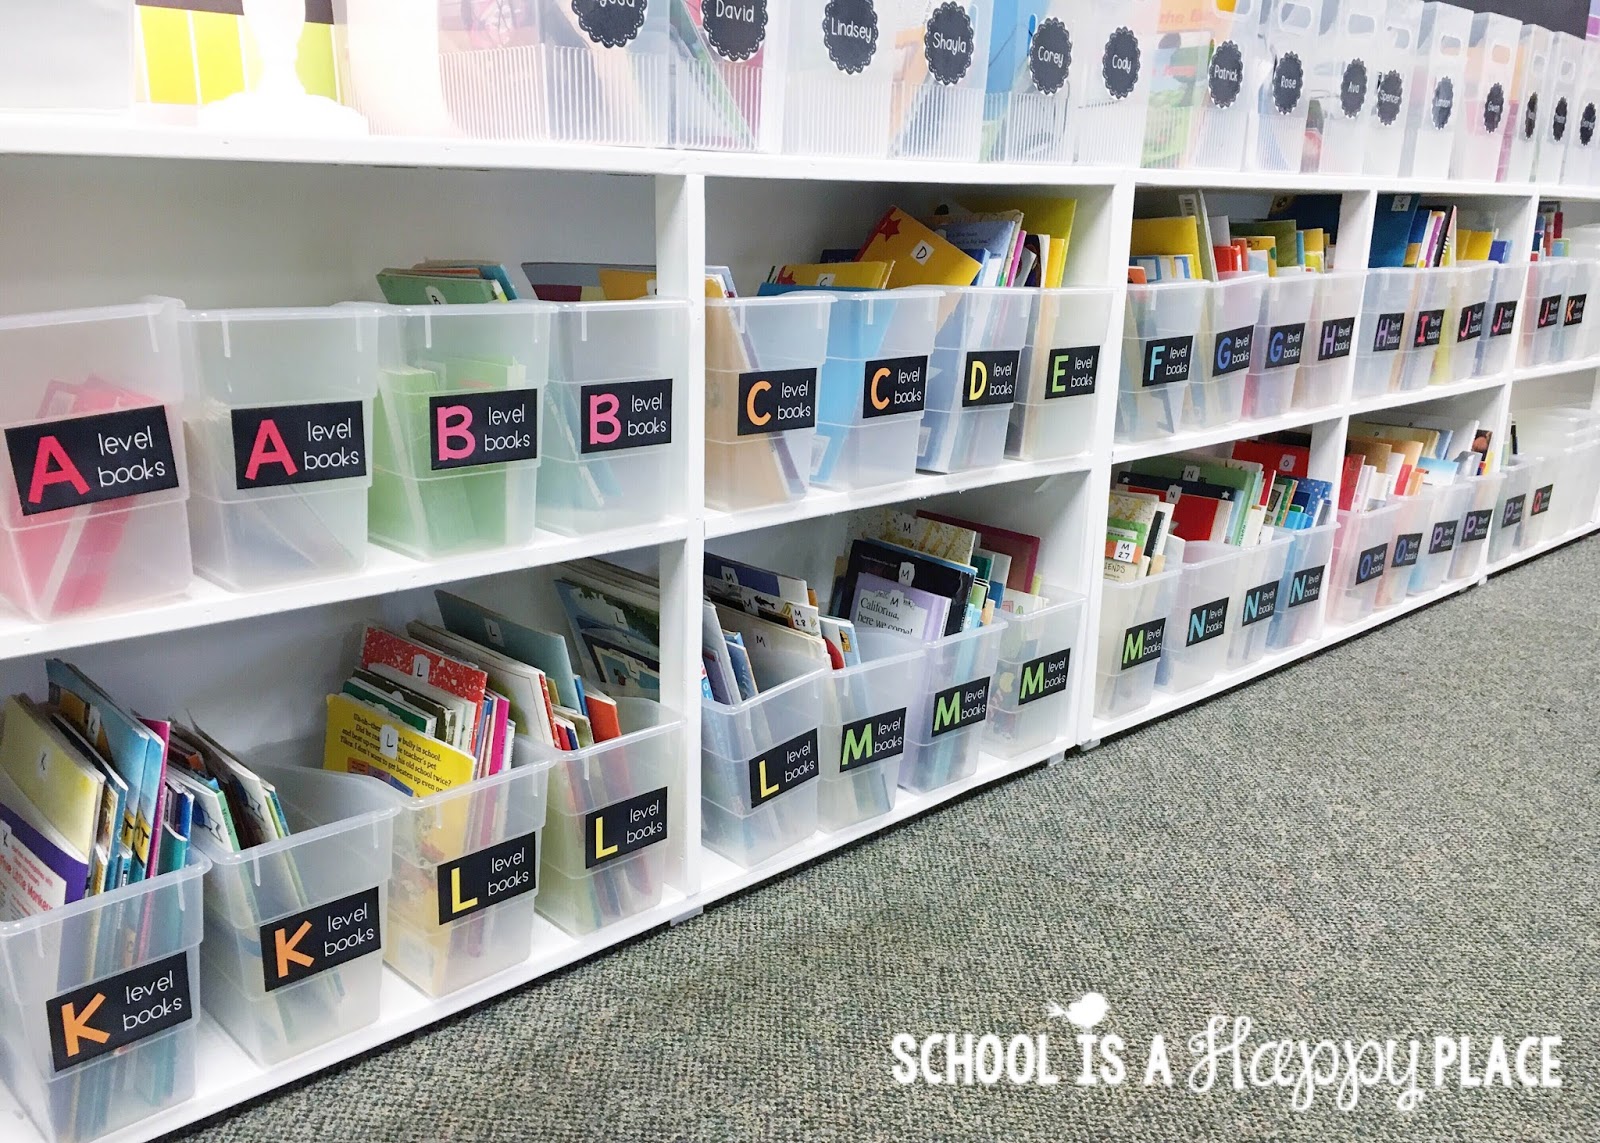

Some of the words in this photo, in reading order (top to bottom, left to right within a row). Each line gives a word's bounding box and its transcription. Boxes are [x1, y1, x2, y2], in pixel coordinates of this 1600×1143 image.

[715, 0, 754, 23] David
[831, 17, 872, 44] Lindsey
[933, 32, 966, 55] Shayla
[1038, 45, 1064, 68] Corey
[1112, 54, 1132, 74] Cody
[1214, 64, 1238, 82] Patrick
[1280, 75, 1297, 89] Rose
[1347, 81, 1360, 93] Ava
[1380, 90, 1400, 104] Spencer
[916, 246, 927, 259] D
[1493, 307, 1503, 333] J
[1540, 301, 1549, 325] J
[1566, 300, 1575, 322] K
[1391, 320, 1401, 331] level
[1417, 315, 1429, 343] I
[1430, 316, 1441, 327] level
[1461, 311, 1471, 337] J
[1235, 334, 1249, 347] level
[1287, 331, 1300, 344] level
[1322, 325, 1336, 356] H
[1338, 326, 1350, 337] level
[1376, 319, 1389, 347] H
[1387, 334, 1400, 344] books
[1427, 330, 1439, 340] books
[1170, 345, 1187, 359] level
[1217, 337, 1231, 369] G
[1270, 331, 1283, 362] G
[1283, 346, 1300, 358] books
[1334, 339, 1349, 351] books
[1075, 355, 1093, 370] level
[1150, 345, 1165, 380] F
[1232, 351, 1249, 364] books
[898, 367, 920, 384] level
[993, 362, 1012, 377] level
[1052, 355, 1069, 393] E
[1165, 362, 1187, 375] books
[781, 380, 808, 398] level
[871, 367, 891, 410] C
[969, 360, 987, 400] D
[989, 381, 1012, 396] books
[1070, 374, 1093, 387] books
[631, 393, 663, 412] level
[747, 380, 772, 426] C
[894, 388, 921, 404] books
[488, 404, 525, 426] level
[589, 392, 622, 444] B
[777, 403, 811, 420] books
[308, 418, 351, 441] level
[437, 404, 476, 460] B
[628, 417, 667, 436] books
[98, 426, 152, 456] level
[245, 419, 298, 480] A
[484, 430, 530, 451] books
[304, 447, 359, 470] books
[28, 436, 91, 503] A
[98, 458, 165, 487] books
[1187, 470, 1194, 478] N
[1504, 501, 1514, 523] P
[903, 522, 911, 533] M
[1465, 515, 1476, 538] P
[1431, 526, 1443, 550] P
[1118, 551, 1130, 560] 2.7
[1373, 550, 1384, 563] level
[1396, 539, 1406, 563] O
[901, 570, 909, 580] M
[1360, 554, 1371, 579] O
[1370, 563, 1383, 575] books
[725, 573, 733, 583] M
[1308, 572, 1320, 585] level
[1262, 588, 1275, 601] level
[1290, 575, 1306, 603] N
[1305, 585, 1319, 598] books
[743, 599, 752, 609] M
[890, 597, 899, 608] M
[1244, 591, 1260, 622] N
[1259, 602, 1274, 615] books
[616, 612, 624, 624] L
[795, 609, 801, 618] M
[858, 611, 874, 626] here
[1209, 605, 1224, 620] level
[489, 625, 497, 637] L
[1146, 626, 1162, 641] level
[1189, 609, 1206, 642] N
[1206, 620, 1223, 634] books
[756, 635, 766, 647] M
[1123, 630, 1144, 664] M
[1143, 641, 1162, 656] books
[417, 663, 423, 677] L
[628, 661, 637, 674] L
[1048, 657, 1066, 673] level
[1020, 662, 1044, 699] M
[1045, 674, 1066, 689] books
[965, 686, 985, 703] level
[934, 691, 960, 731] M
[961, 703, 985, 719] books
[878, 717, 901, 735] level
[387, 734, 393, 747] L
[403, 737, 415, 751] bully
[416, 745, 421, 753] in
[842, 723, 872, 765] M
[874, 736, 902, 753] books
[403, 749, 426, 765] teacher's
[427, 762, 437, 770] pet
[787, 741, 810, 764] level
[406, 761, 414, 770] old
[414, 765, 432, 779] school
[432, 774, 452, 787] twice?
[759, 760, 779, 798] L
[785, 760, 814, 782] books
[421, 779, 435, 790] even
[630, 800, 659, 823] level
[596, 817, 618, 859] L
[626, 821, 662, 844] books
[491, 847, 524, 874] level
[451, 867, 477, 914] L
[488, 871, 529, 897] books
[328, 903, 367, 932] level
[275, 920, 314, 978] K
[325, 928, 374, 957] books
[126, 970, 173, 1004] level
[123, 998, 182, 1031] books
[62, 993, 110, 1057] K
